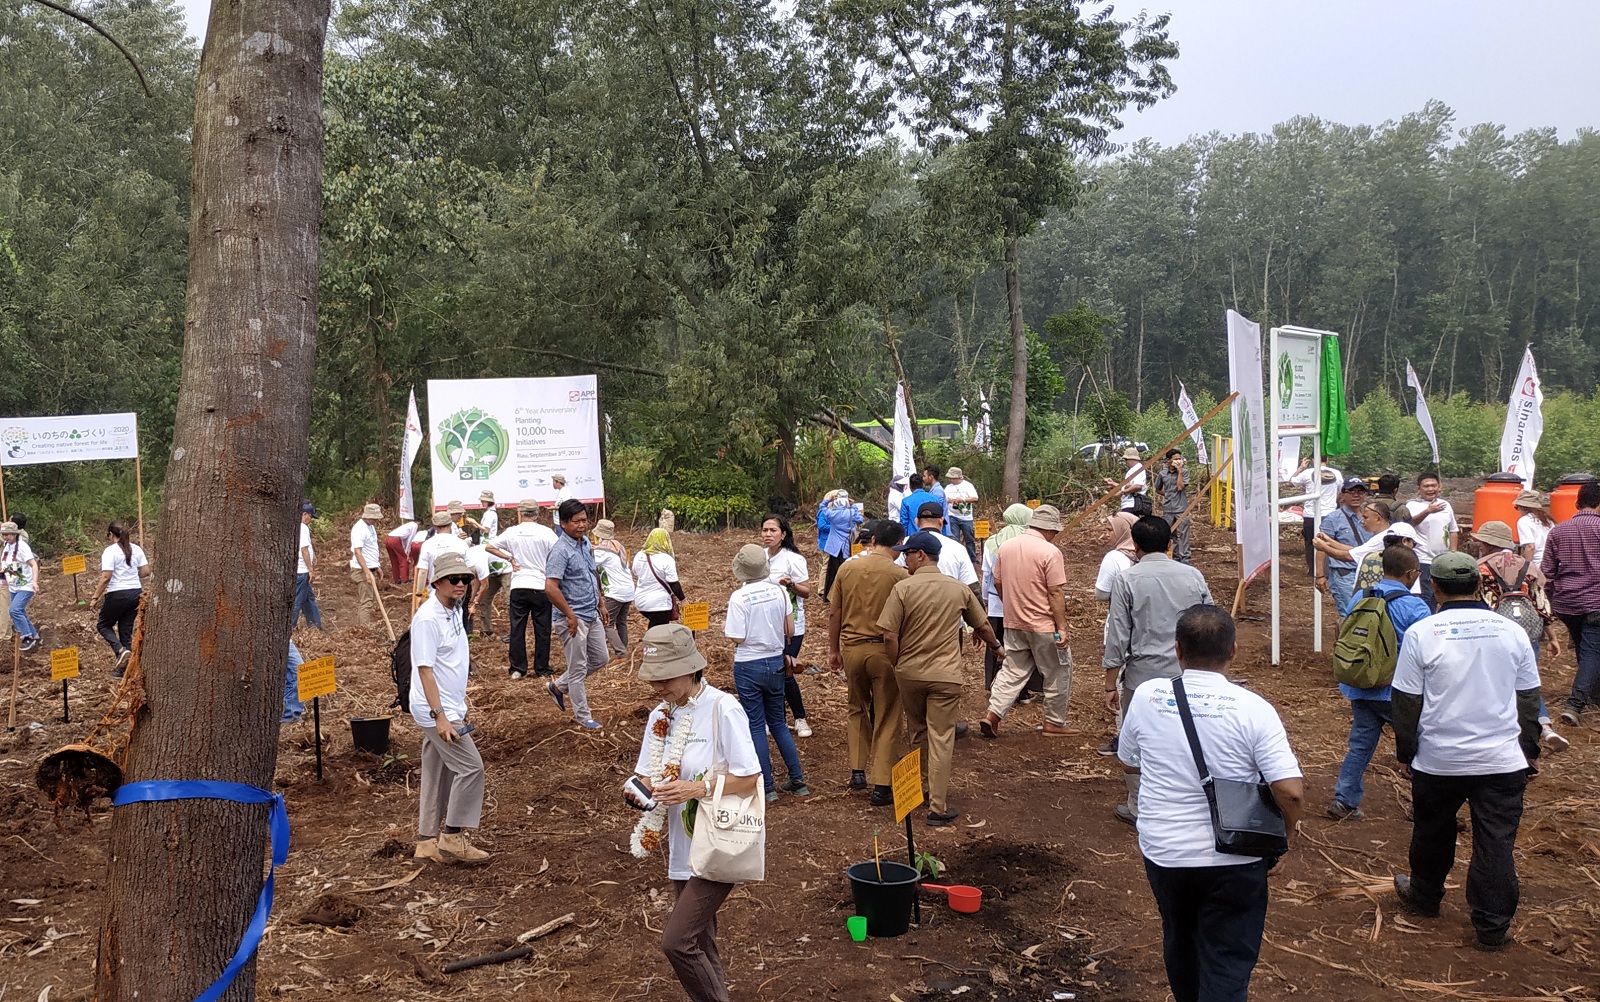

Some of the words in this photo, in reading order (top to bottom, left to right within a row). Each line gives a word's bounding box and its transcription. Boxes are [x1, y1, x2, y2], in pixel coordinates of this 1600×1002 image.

[540, 405, 577, 414] Anniversary
[515, 417, 541, 425] Planting
[32, 430, 69, 441] いのちの
[81, 428, 106, 438] づくり
[517, 426, 547, 437] 10,000
[1511, 400, 1533, 462] sinarmas
[515, 438, 546, 446] Initiatives
[529, 451, 557, 459] September
